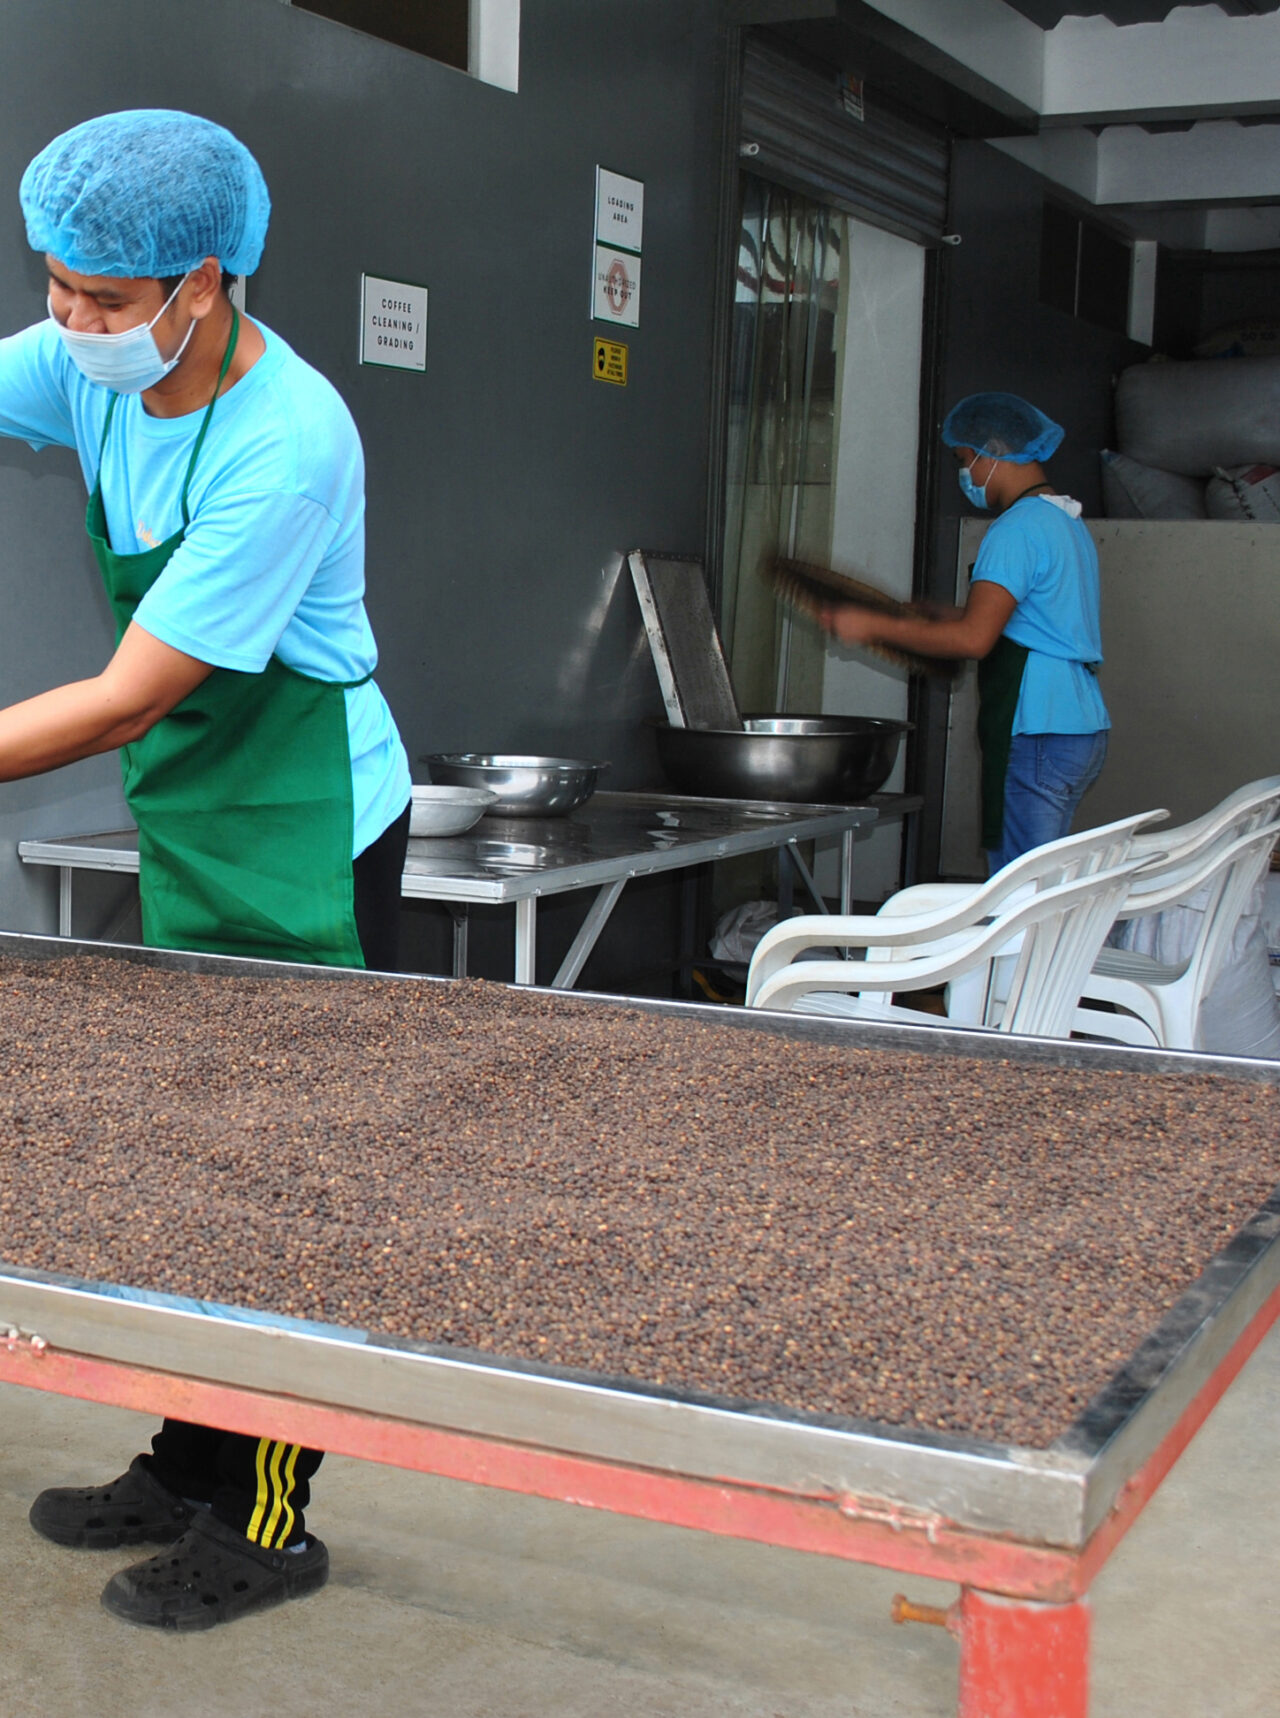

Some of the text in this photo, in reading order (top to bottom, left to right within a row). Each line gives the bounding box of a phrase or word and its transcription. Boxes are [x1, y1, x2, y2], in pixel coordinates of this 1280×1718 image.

[613, 212, 627, 223] AREA
[381, 298, 411, 313] COFFEE
[372, 315, 413, 332] CLEANING
[377, 335, 414, 351] GRADING
